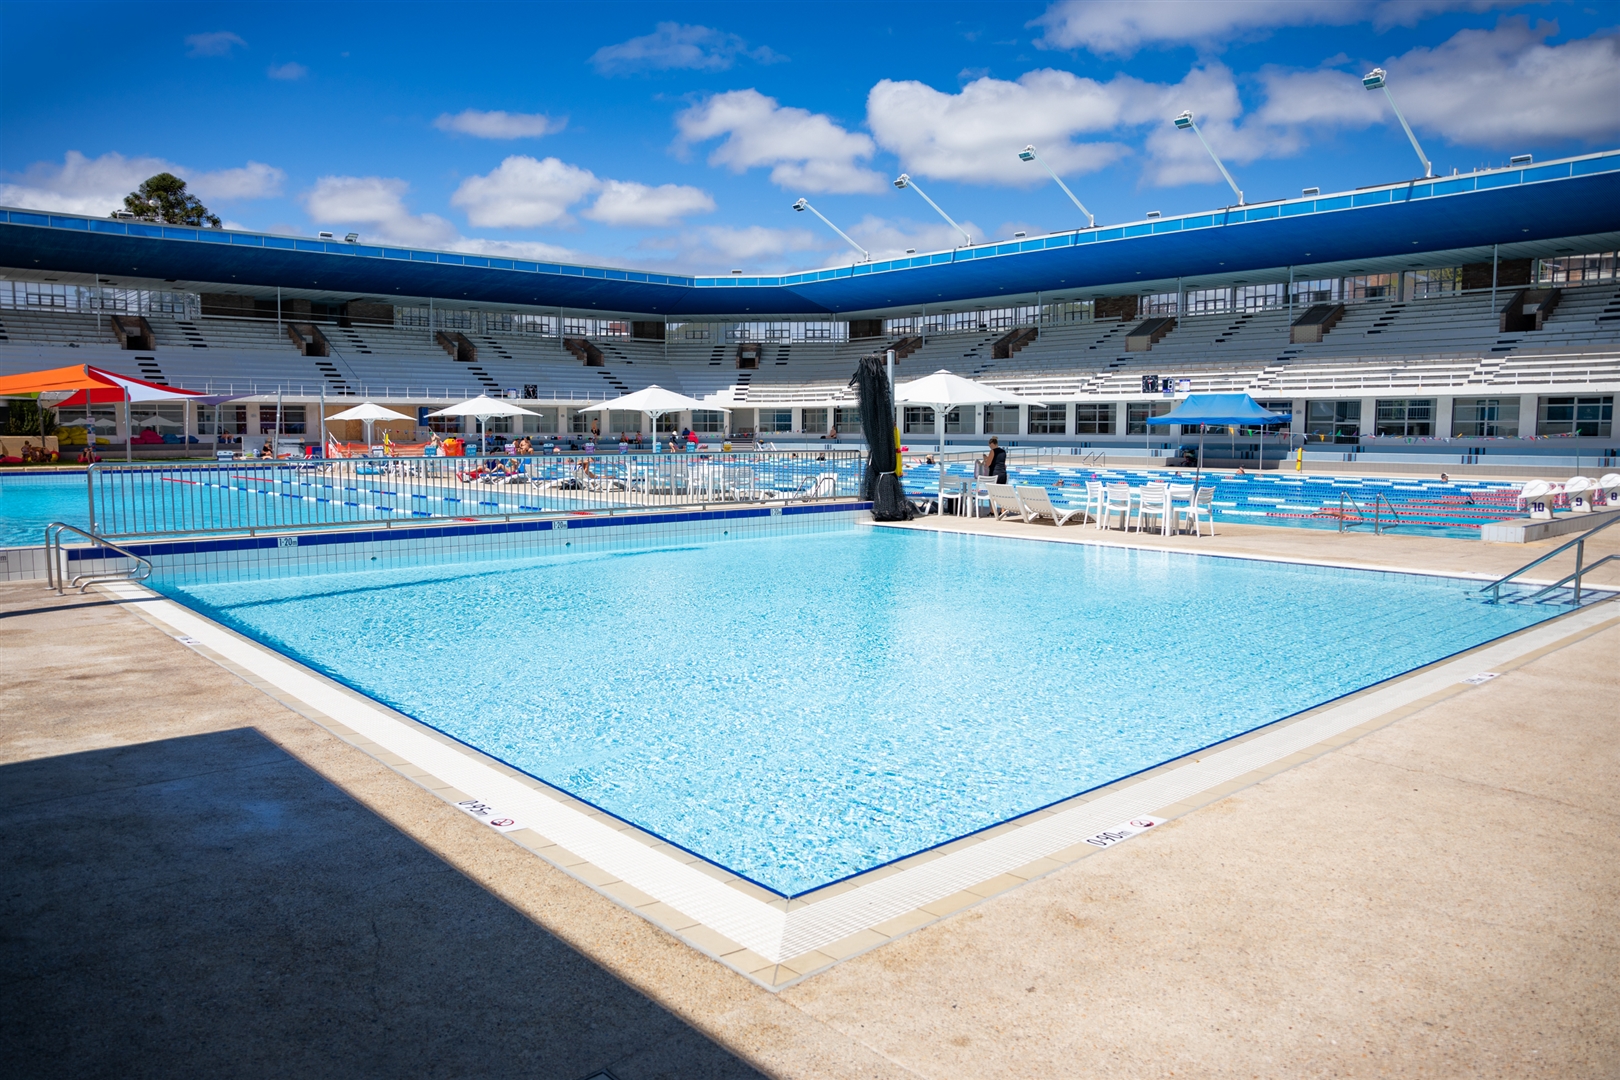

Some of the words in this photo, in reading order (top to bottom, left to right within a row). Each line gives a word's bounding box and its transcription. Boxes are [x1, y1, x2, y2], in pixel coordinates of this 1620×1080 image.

[1611, 491, 1618, 501] 8
[1532, 502, 1545, 512] 10
[1575, 497, 1583, 507] 9
